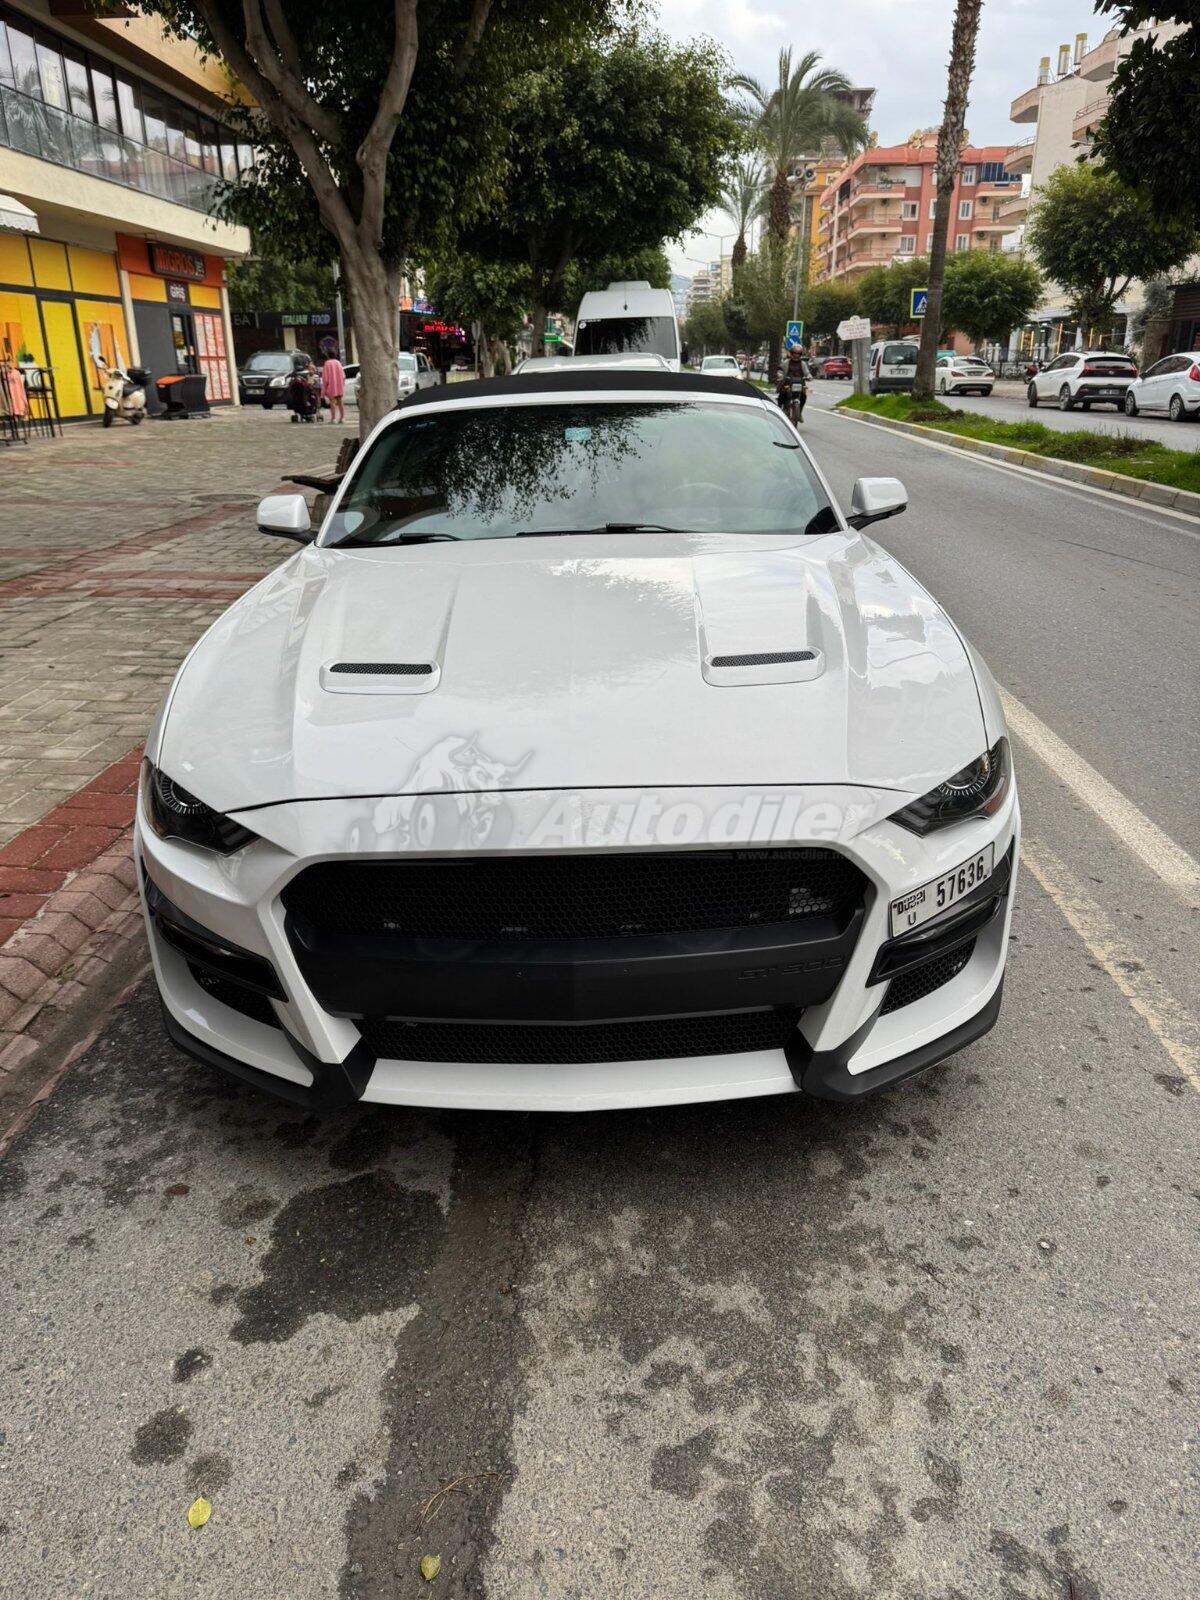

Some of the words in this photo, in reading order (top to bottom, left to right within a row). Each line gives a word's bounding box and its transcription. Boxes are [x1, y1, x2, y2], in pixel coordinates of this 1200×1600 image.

[281, 314, 308, 326] ITALIAN
[311, 314, 331, 325] FOOD
[936, 855, 984, 907] 57636
[907, 911, 917, 926] U
